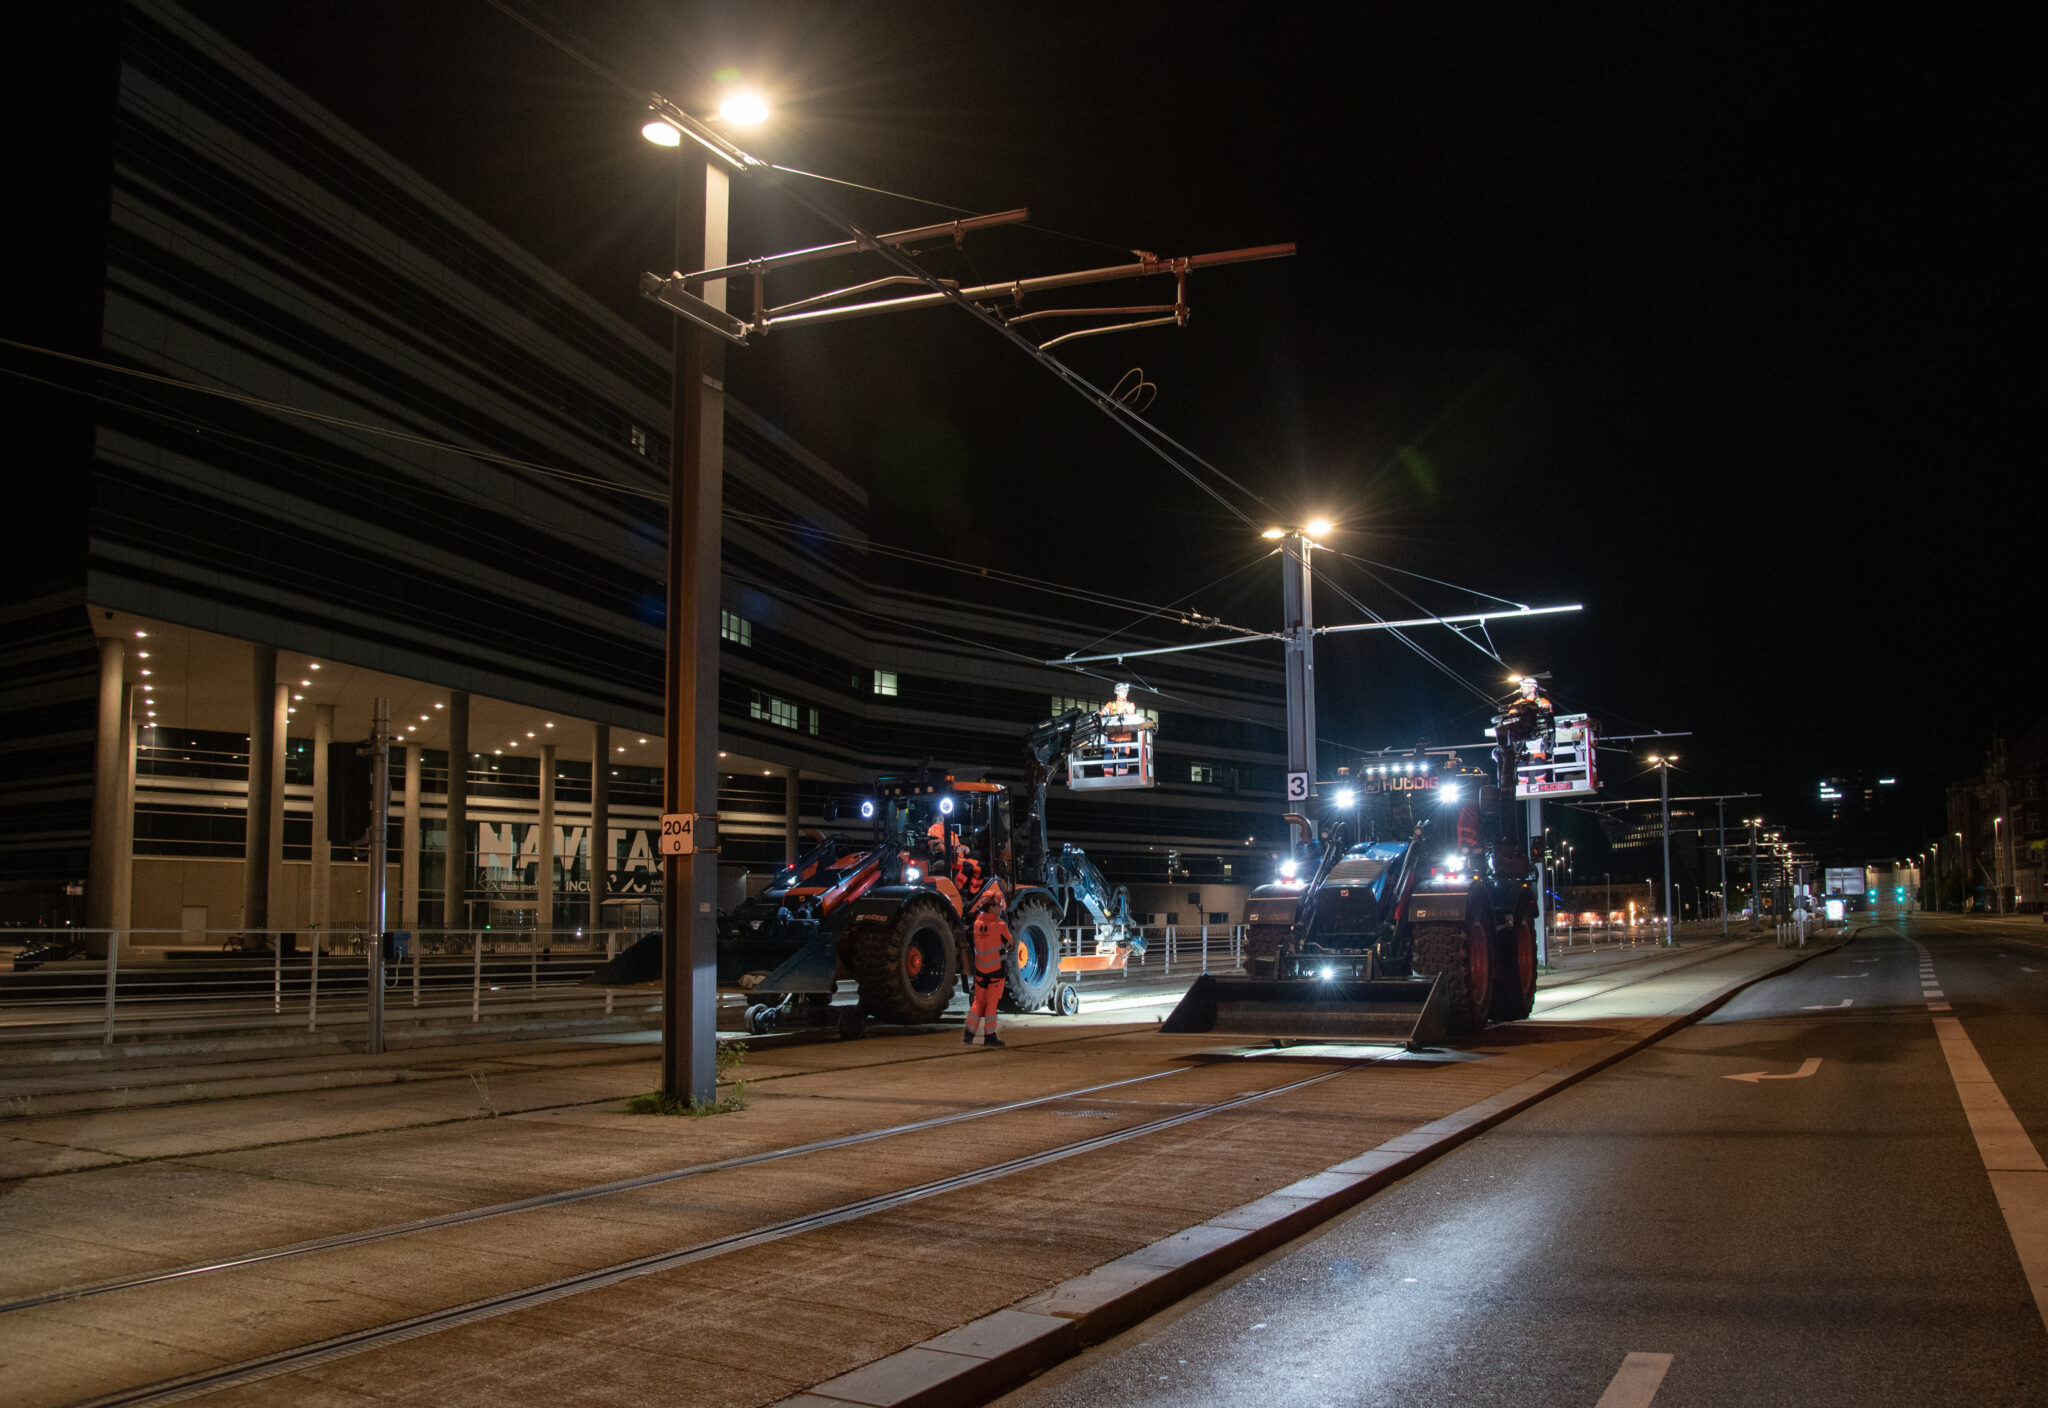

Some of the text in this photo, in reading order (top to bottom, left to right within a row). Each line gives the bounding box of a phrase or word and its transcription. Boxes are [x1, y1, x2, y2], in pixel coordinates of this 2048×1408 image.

[1290, 776, 1305, 797] 3
[664, 820, 691, 835] 204
[478, 822, 664, 873] NAVITA
[673, 840, 681, 852] 0
